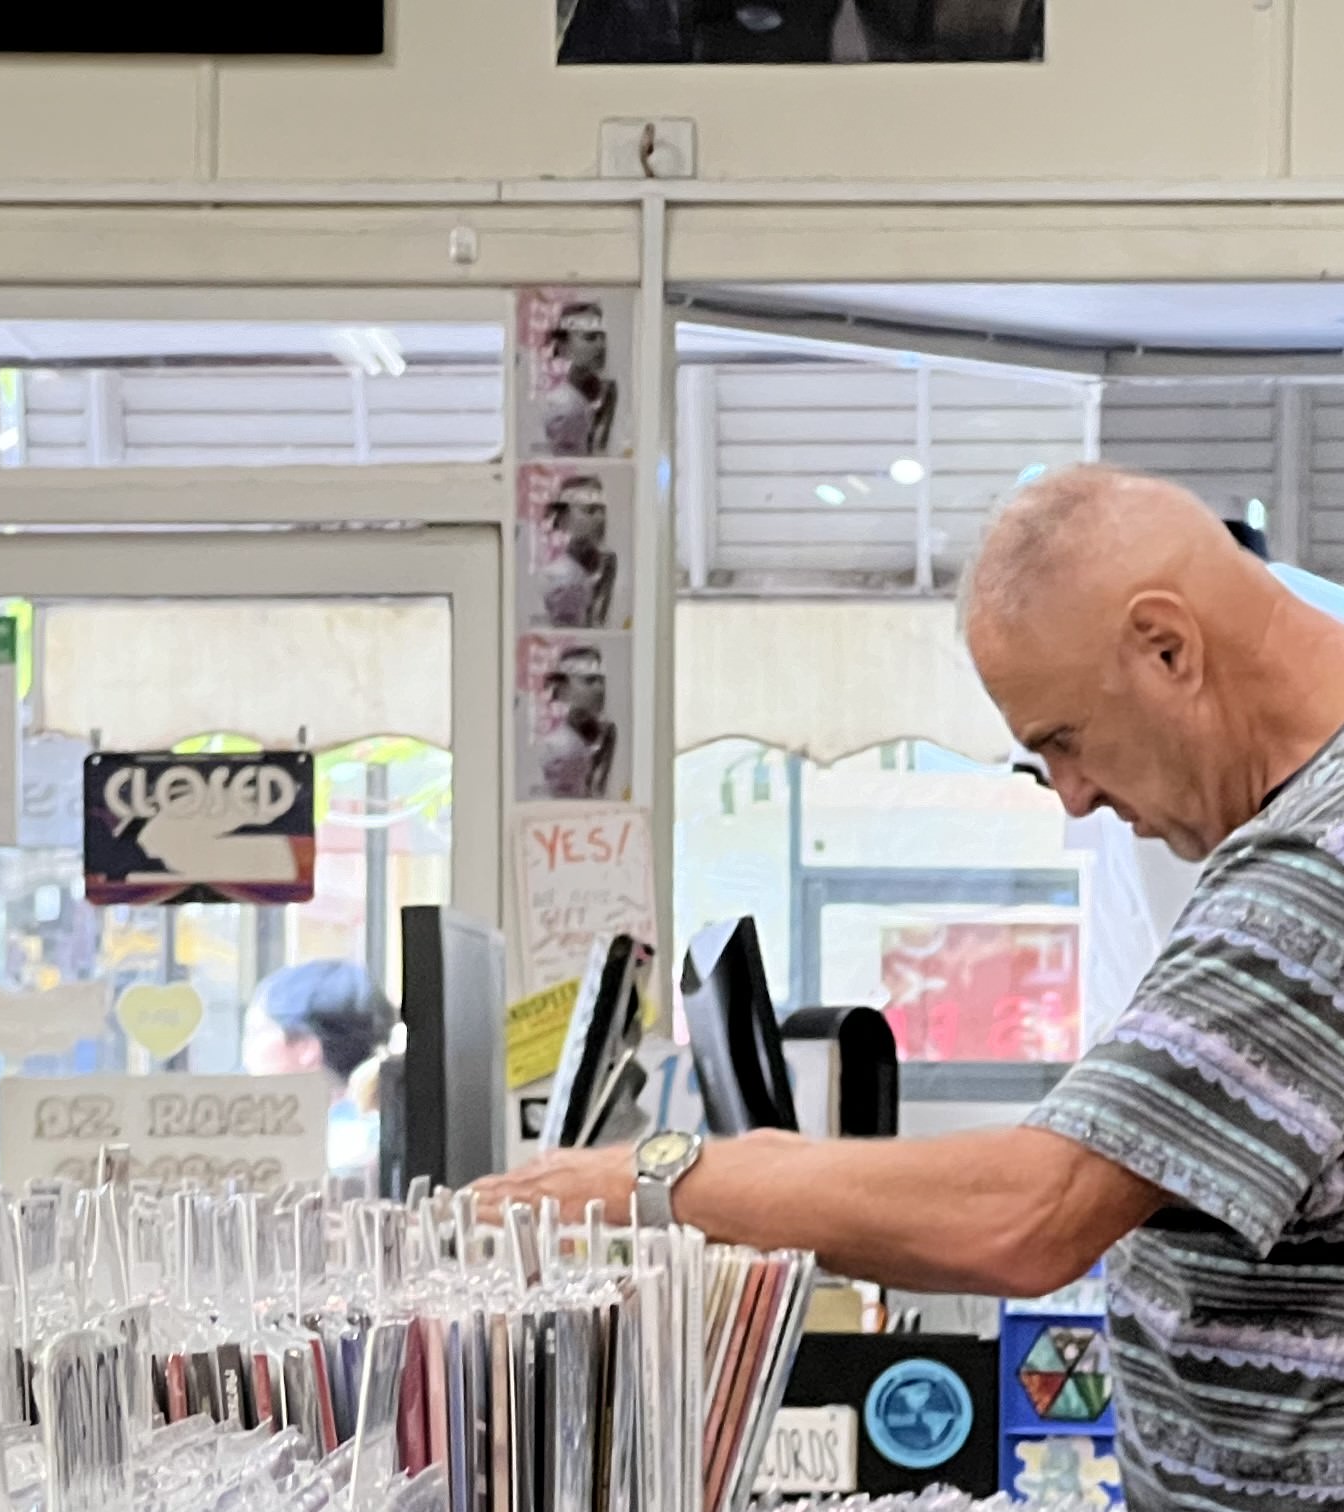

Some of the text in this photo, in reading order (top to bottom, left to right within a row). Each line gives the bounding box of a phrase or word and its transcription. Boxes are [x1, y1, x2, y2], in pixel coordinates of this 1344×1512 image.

[103, 764, 297, 836] CLOSED
[533, 821, 630, 872] YES!
[147, 1092, 305, 1138] ROCK
